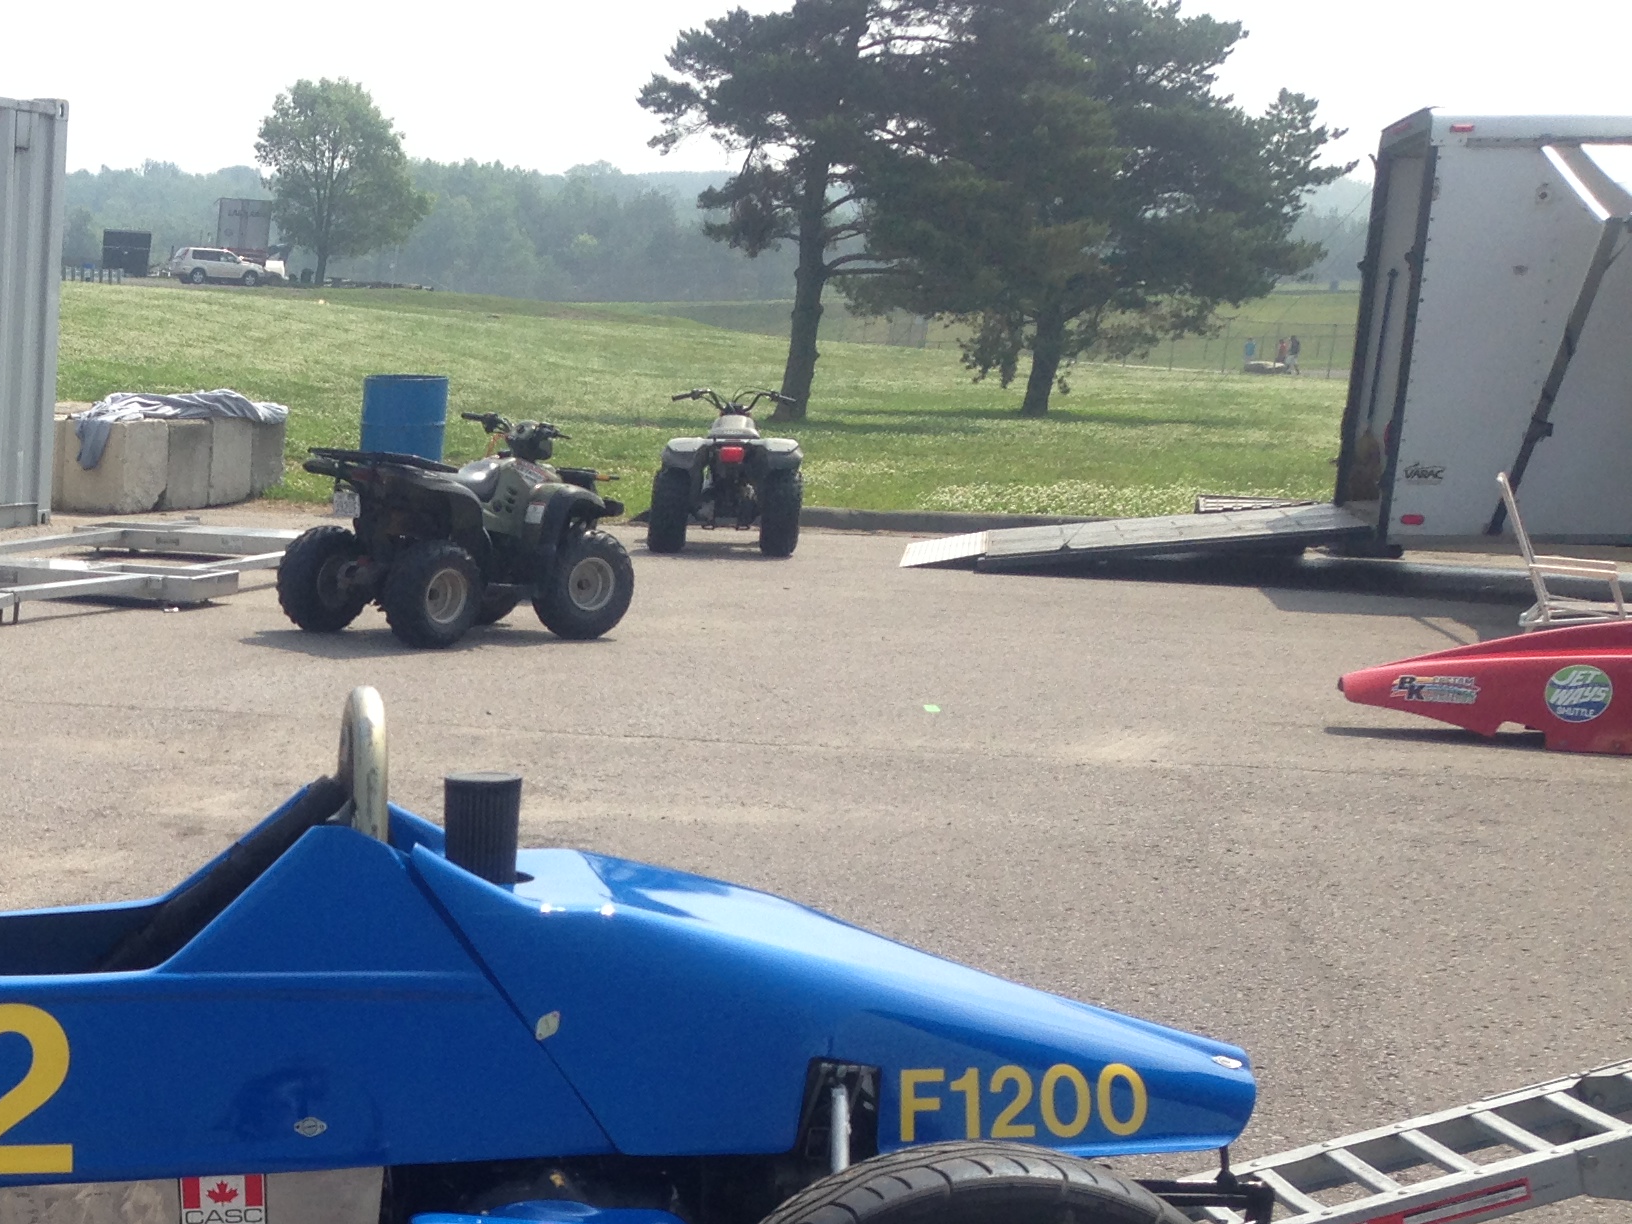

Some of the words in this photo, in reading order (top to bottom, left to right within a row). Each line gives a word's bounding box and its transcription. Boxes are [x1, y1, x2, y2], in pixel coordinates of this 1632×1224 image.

[1551, 670, 1603, 687] JET
[1549, 686, 1610, 706] WAYS
[1556, 706, 1595, 718] SHUTTLE
[900, 1063, 1148, 1142] F1200
[185, 1208, 262, 1224] CASC
